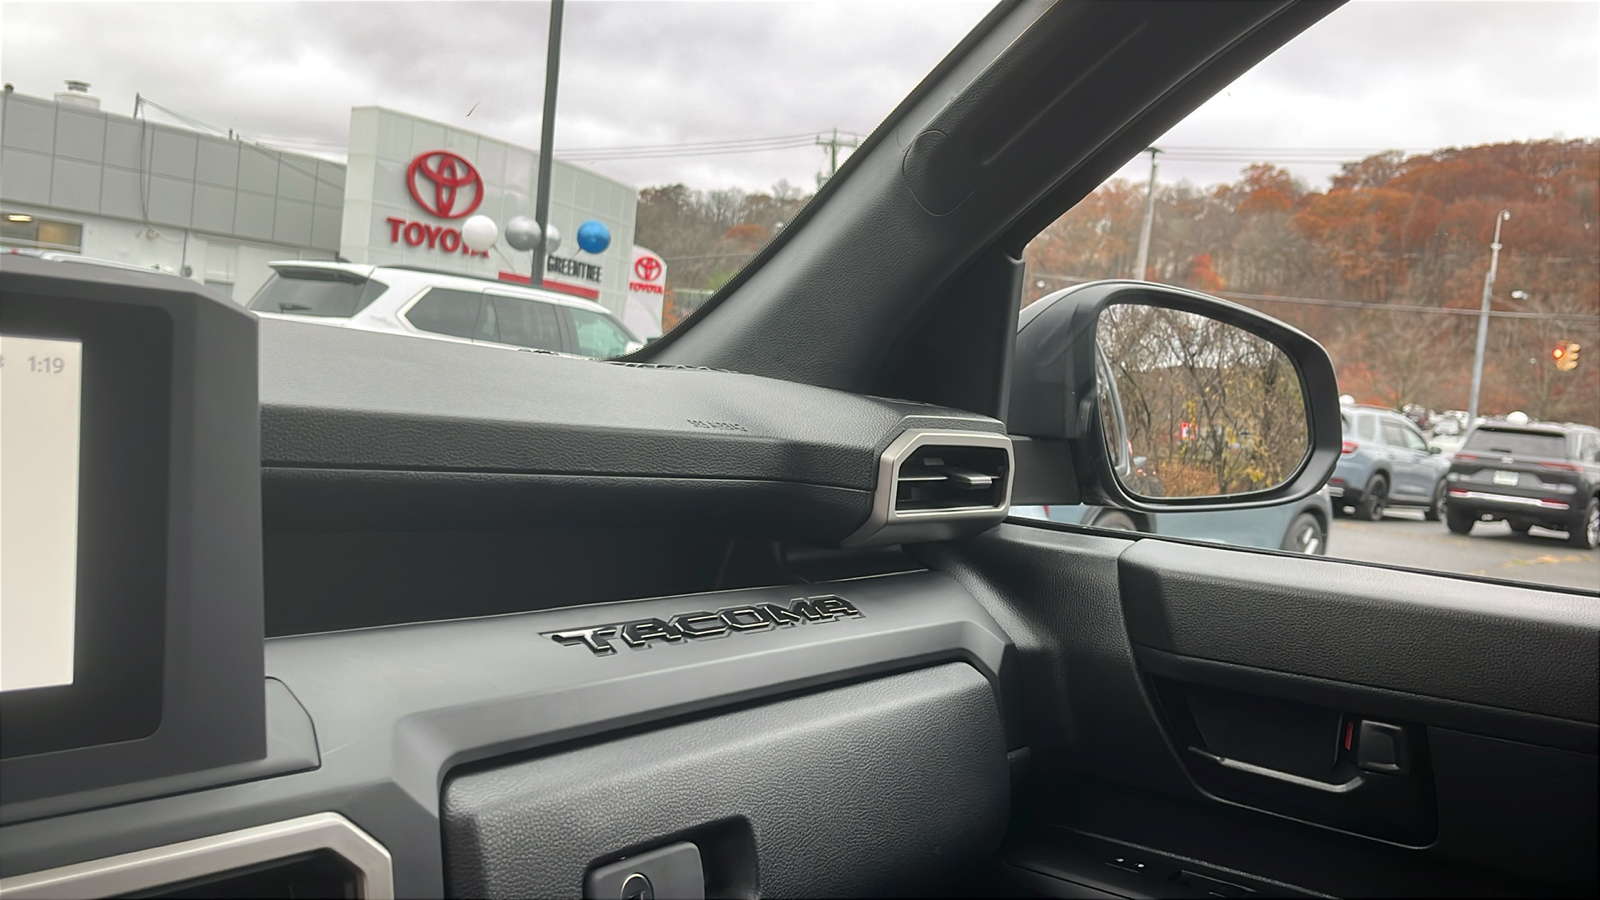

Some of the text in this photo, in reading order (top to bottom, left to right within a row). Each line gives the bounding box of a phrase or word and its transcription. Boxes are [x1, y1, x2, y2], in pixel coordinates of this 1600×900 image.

[386, 216, 489, 258] TOYO
[547, 254, 602, 283] GREENTREE
[629, 281, 664, 294] TOYOTA
[27, 355, 65, 374] 1:19
[538, 594, 866, 657] TACOMA
